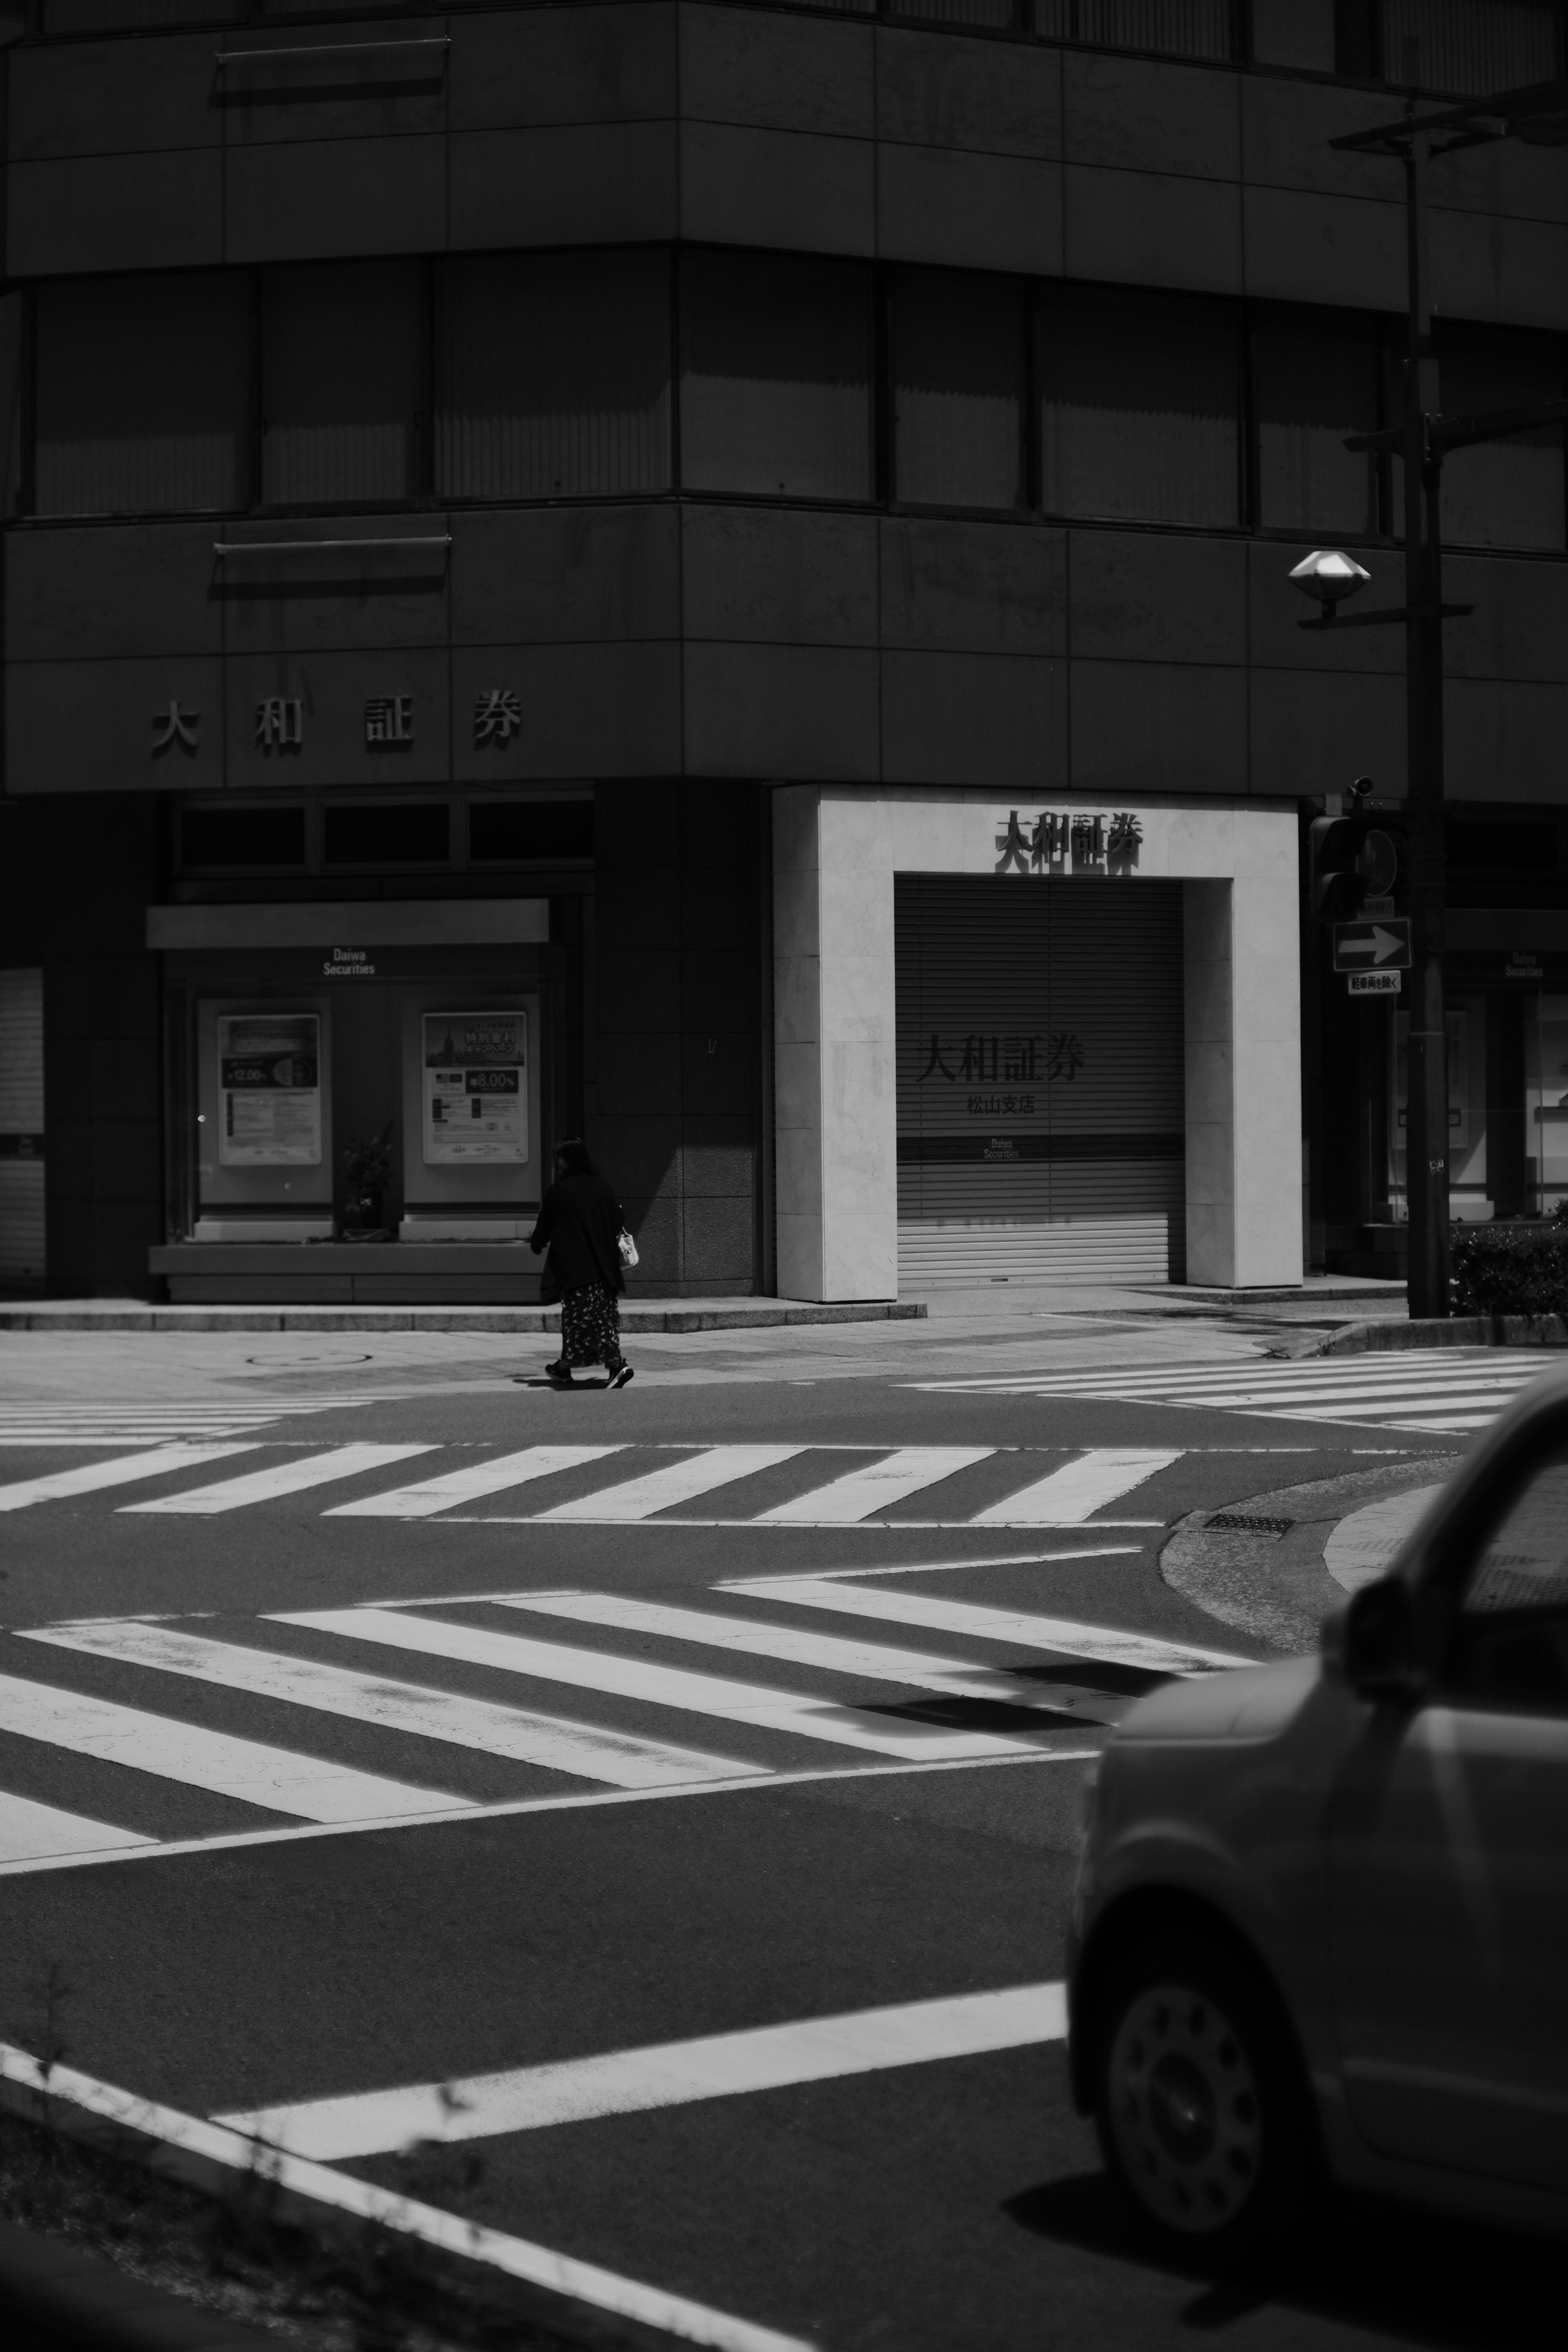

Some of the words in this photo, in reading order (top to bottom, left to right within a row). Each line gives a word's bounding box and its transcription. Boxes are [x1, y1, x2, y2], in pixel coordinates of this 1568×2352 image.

[152, 688, 522, 751] 大和証券
[997, 810, 1142, 855] 大和証券
[333, 947, 366, 961] Daiwa
[323, 962, 375, 976] Securities
[1505, 965, 1543, 977] Securities
[1352, 976, 1397, 989] 軽車両を除く
[916, 1033, 1085, 1082] 大和証券
[967, 1094, 1035, 1115] 松山支店
[991, 1138, 1013, 1149] Daiwa
[984, 1149, 1019, 1160] Securities
